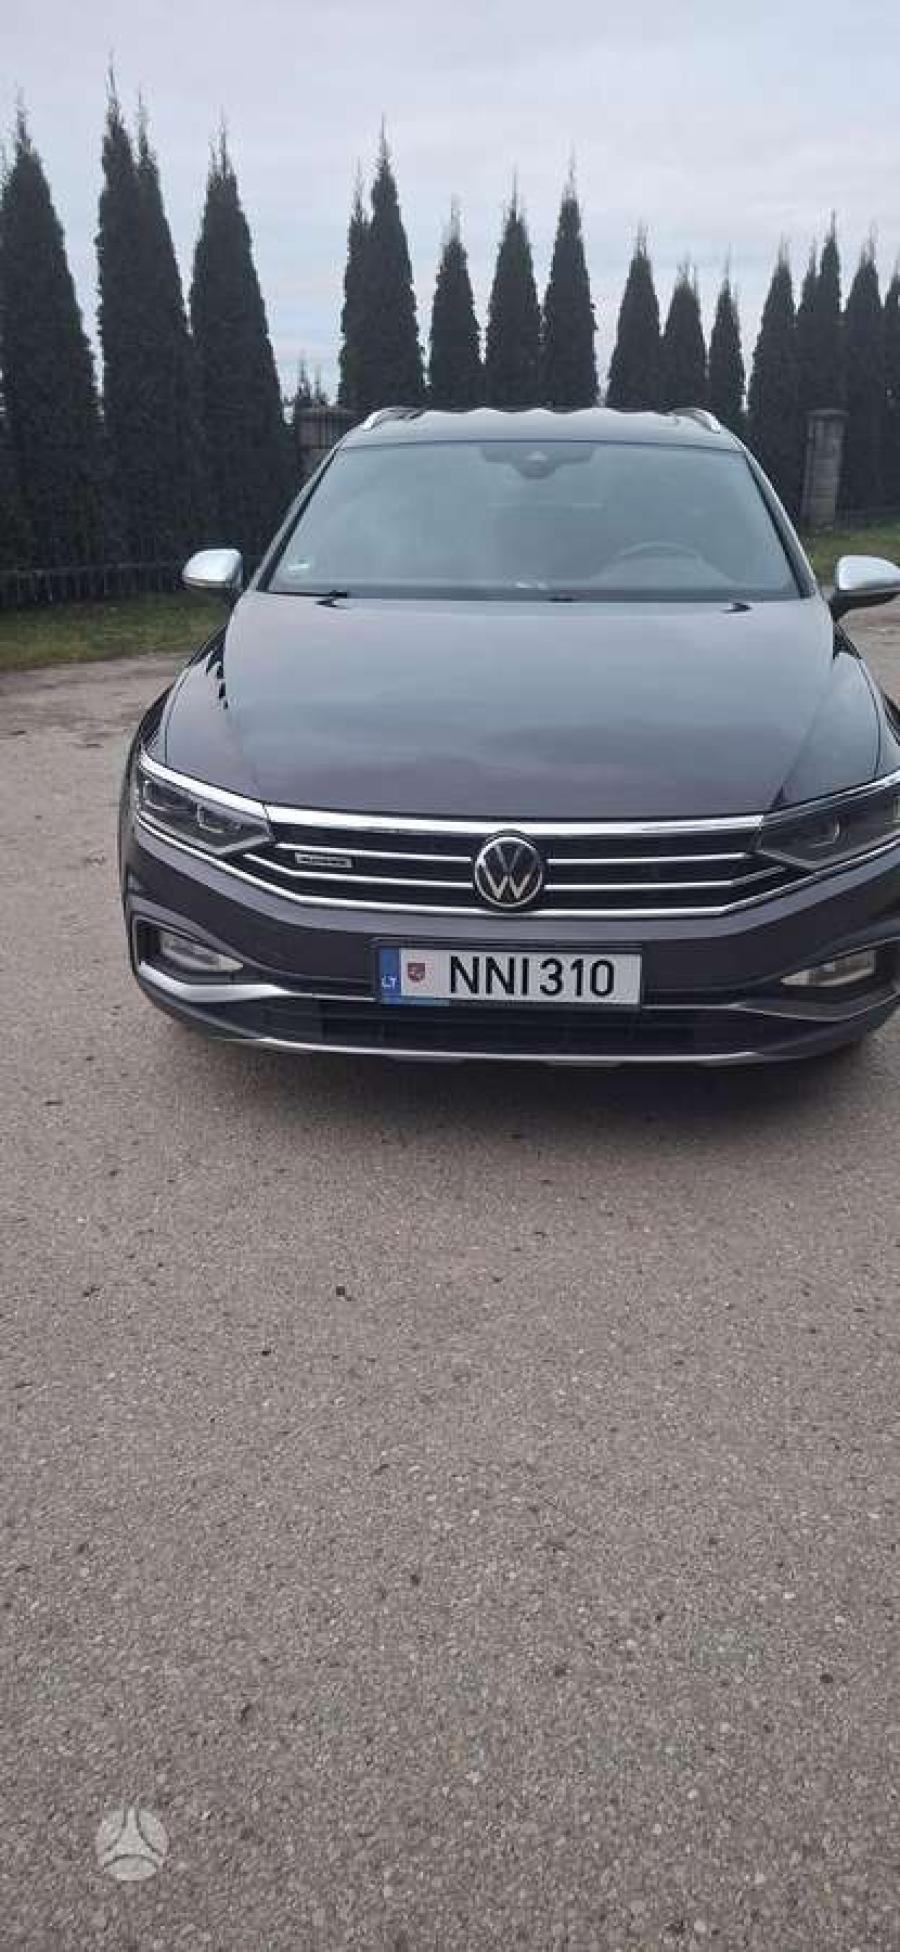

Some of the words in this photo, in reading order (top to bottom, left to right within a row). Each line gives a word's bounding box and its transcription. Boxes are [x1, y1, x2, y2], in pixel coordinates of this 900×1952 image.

[477, 841, 540, 900] VW
[381, 976, 397, 989] LT
[450, 956, 529, 995] NNI
[540, 958, 615, 997] 310
